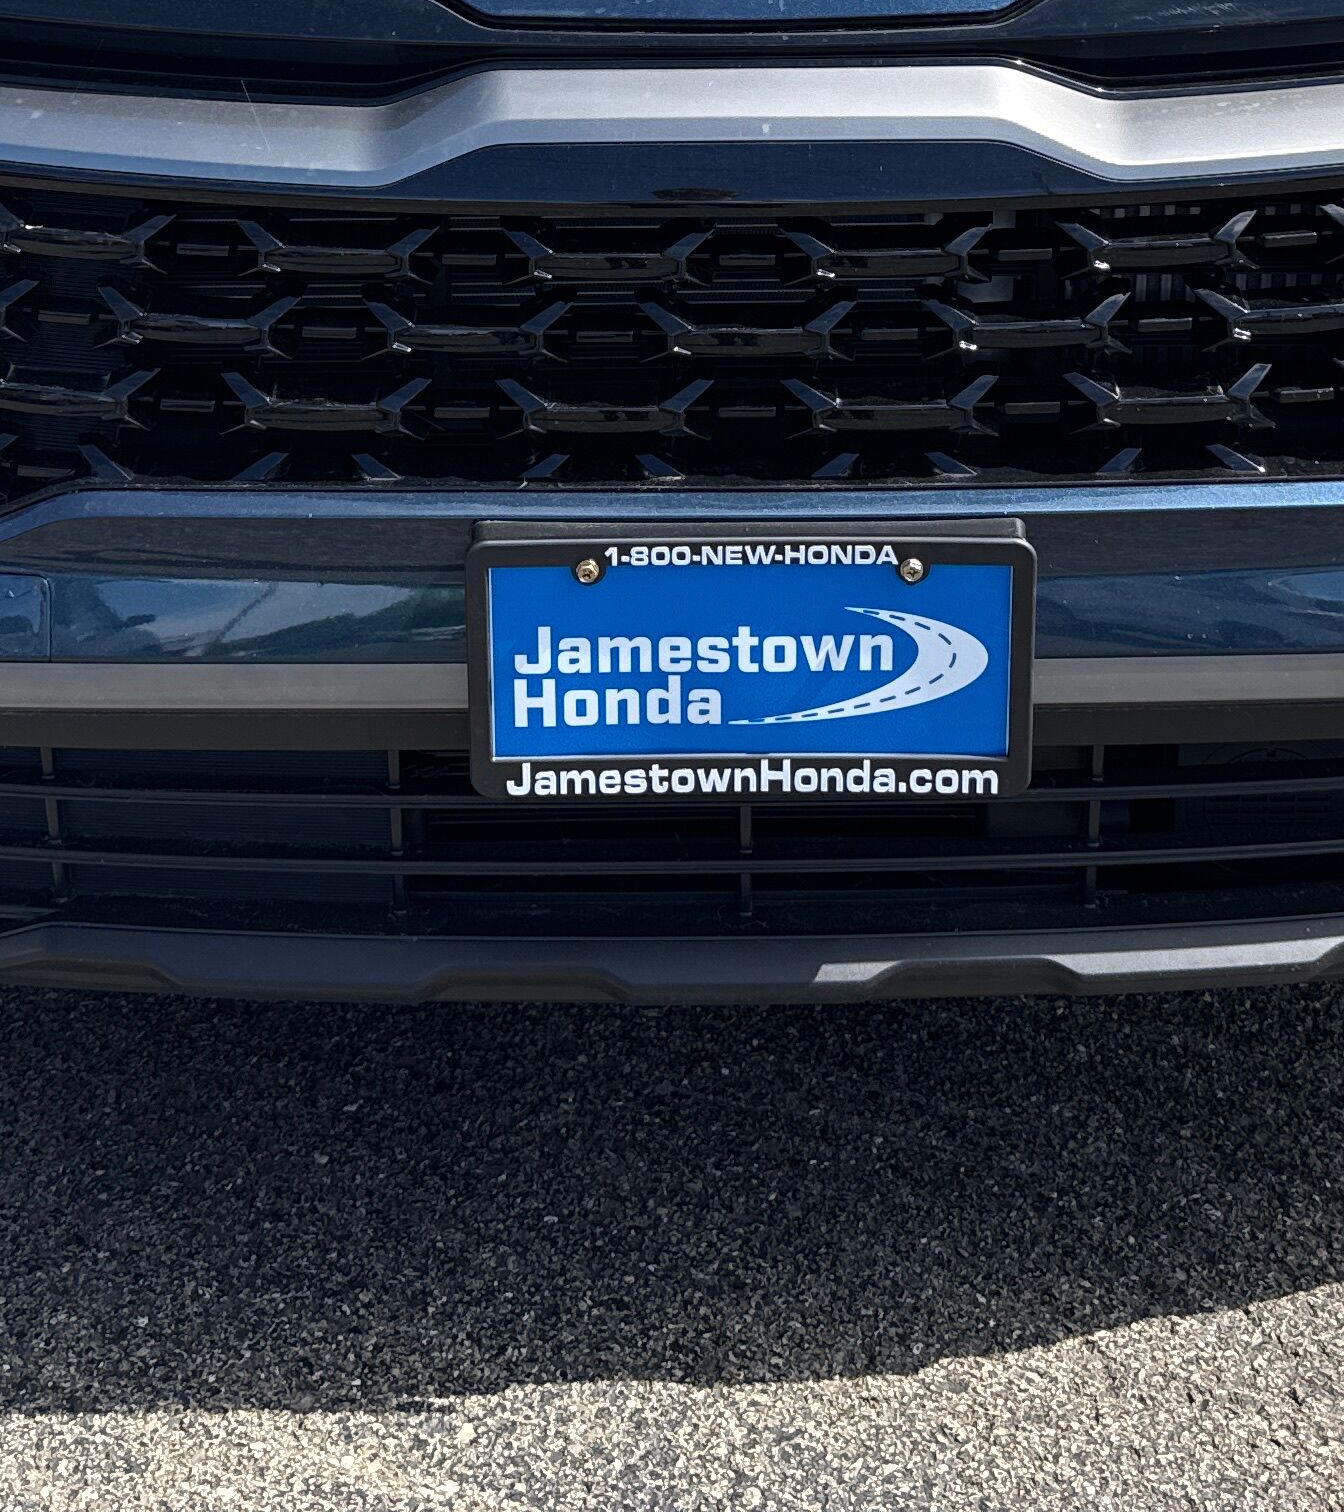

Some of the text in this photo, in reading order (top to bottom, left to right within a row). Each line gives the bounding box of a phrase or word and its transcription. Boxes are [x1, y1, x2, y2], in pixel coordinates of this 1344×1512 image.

[605, 544, 899, 567] 1-800-NEW-HONDA
[514, 626, 894, 675] Jamestown
[514, 675, 722, 728] Honda
[506, 759, 999, 797] JamestownHonda.com
